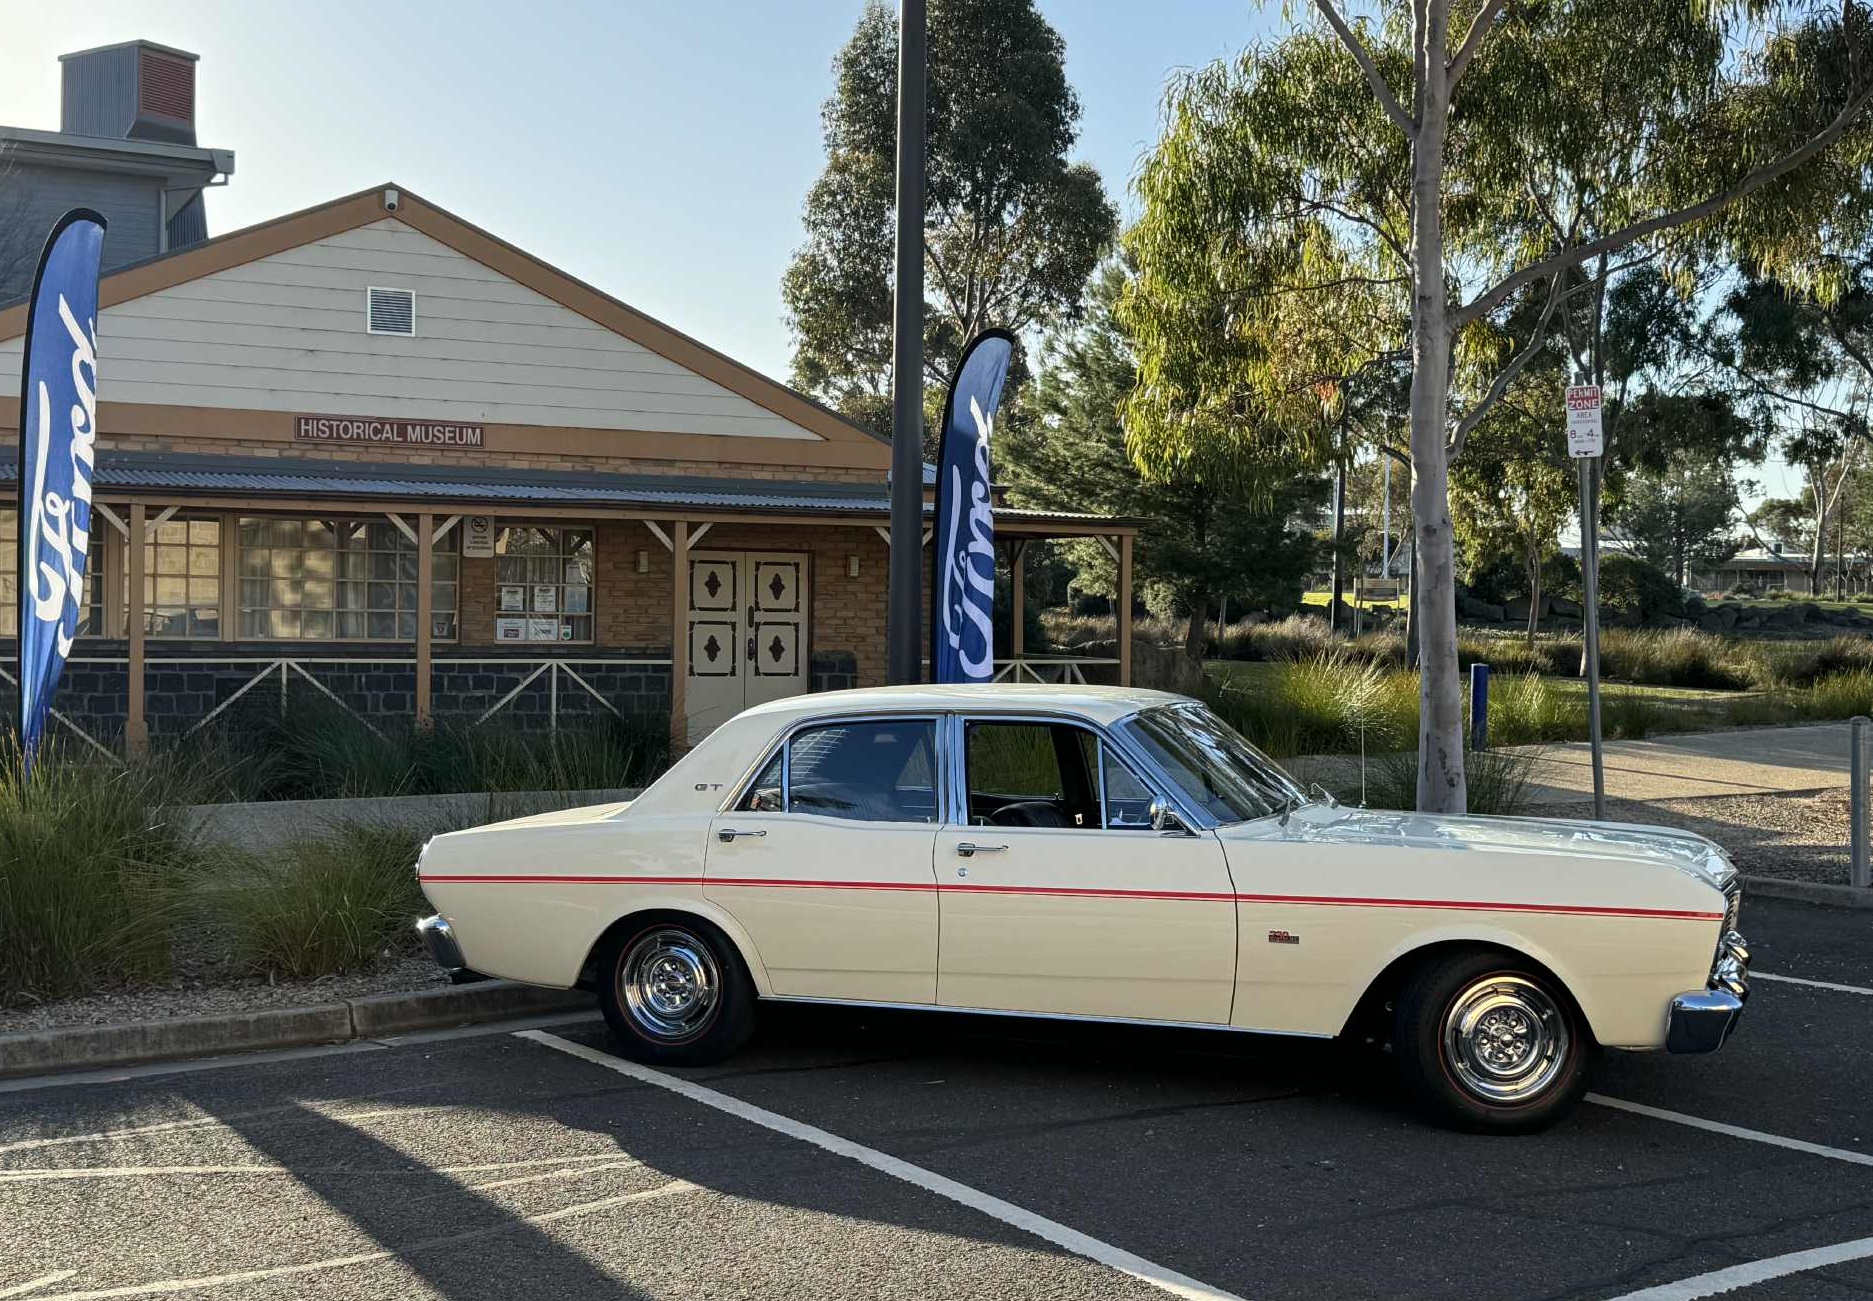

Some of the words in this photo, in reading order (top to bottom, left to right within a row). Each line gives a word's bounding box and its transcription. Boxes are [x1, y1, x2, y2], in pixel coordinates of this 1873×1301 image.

[1568, 388, 1597, 399] PERMIT
[1568, 399, 1599, 410] ZONE
[300, 418, 403, 442] HISTORICAL
[406, 425, 481, 445] MUSEUM
[943, 395, 993, 678] Ford
[694, 783, 724, 792] GT
